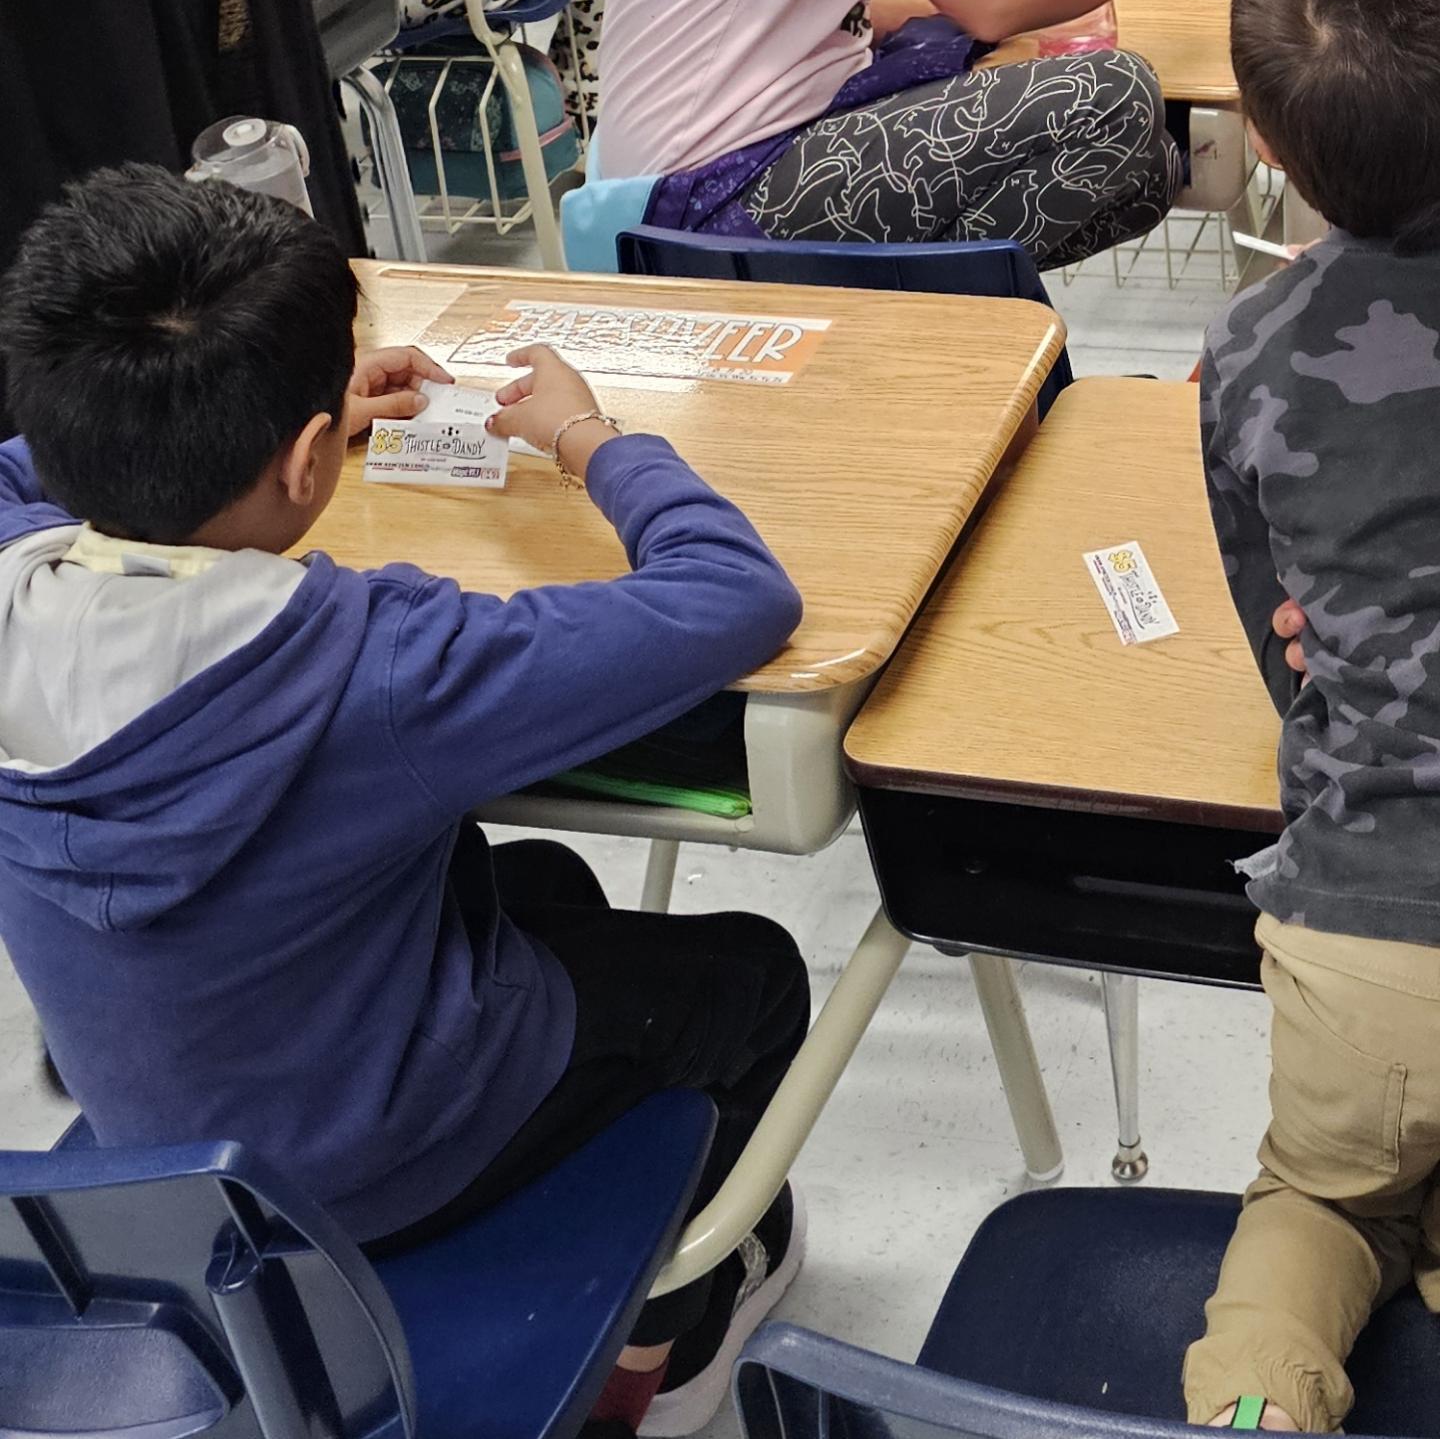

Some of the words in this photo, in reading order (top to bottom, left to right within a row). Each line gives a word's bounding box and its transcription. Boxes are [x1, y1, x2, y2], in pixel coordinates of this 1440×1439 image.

[371, 428, 405, 454] $5
[405, 434, 442, 454] THISTLE
[452, 438, 485, 456] DANDY
